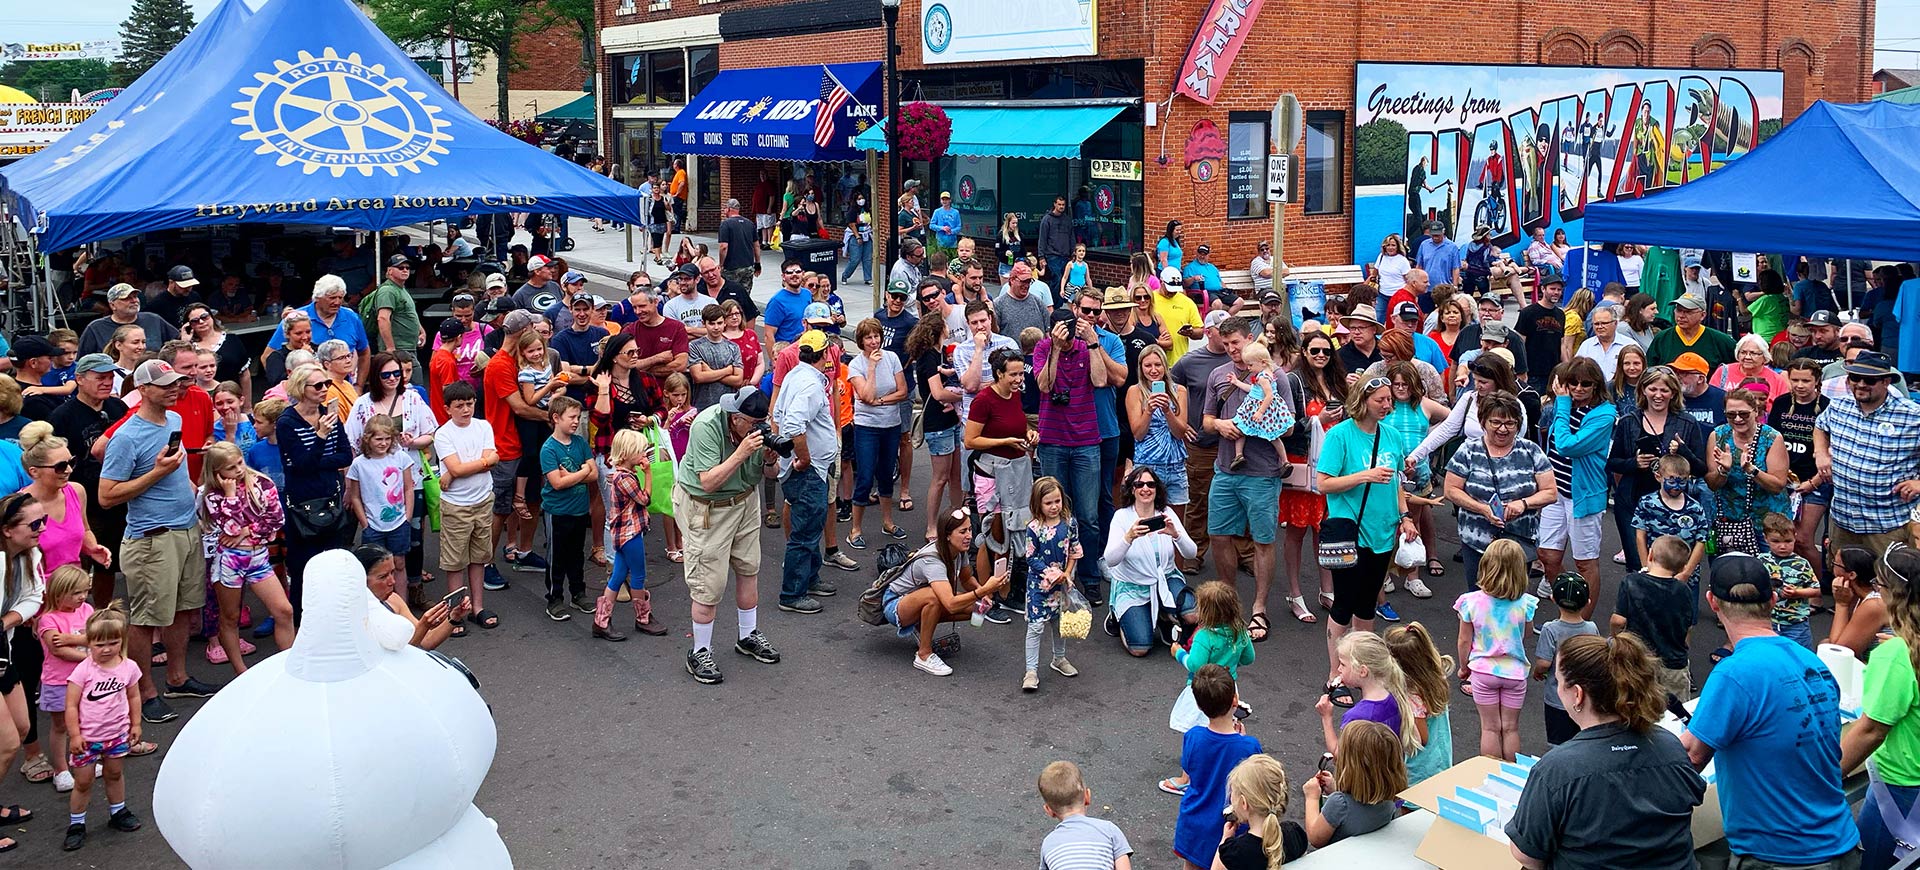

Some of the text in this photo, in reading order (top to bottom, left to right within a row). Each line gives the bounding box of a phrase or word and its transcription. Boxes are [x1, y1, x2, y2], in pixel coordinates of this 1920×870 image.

[26, 43, 82, 53] Festival
[289, 60, 378, 81] ROTARY
[695, 98, 822, 121] LAKE KIDS
[846, 104, 878, 118] LAKE
[1367, 83, 1502, 124] Greetings from
[16, 108, 63, 126] FRENCH
[65, 108, 98, 125] FRIE
[681, 132, 790, 149] TOYS BOOKS GIFTS CLOTHING
[275, 139, 429, 165] INTERNATIONAL
[1092, 160, 1132, 173] OPEN
[1271, 159, 1287, 171] ONE
[1405, 75, 1760, 247] HAYWARD
[1270, 172, 1286, 184] WAY
[194, 194, 539, 220] Hayward Area Rotary Club
[1003, 211, 1027, 220] OEN
[1781, 421, 1814, 431] COULD
[1784, 441, 1807, 454] DID
[1361, 452, 1393, 468] LKE
[94, 677, 125, 692] nike
